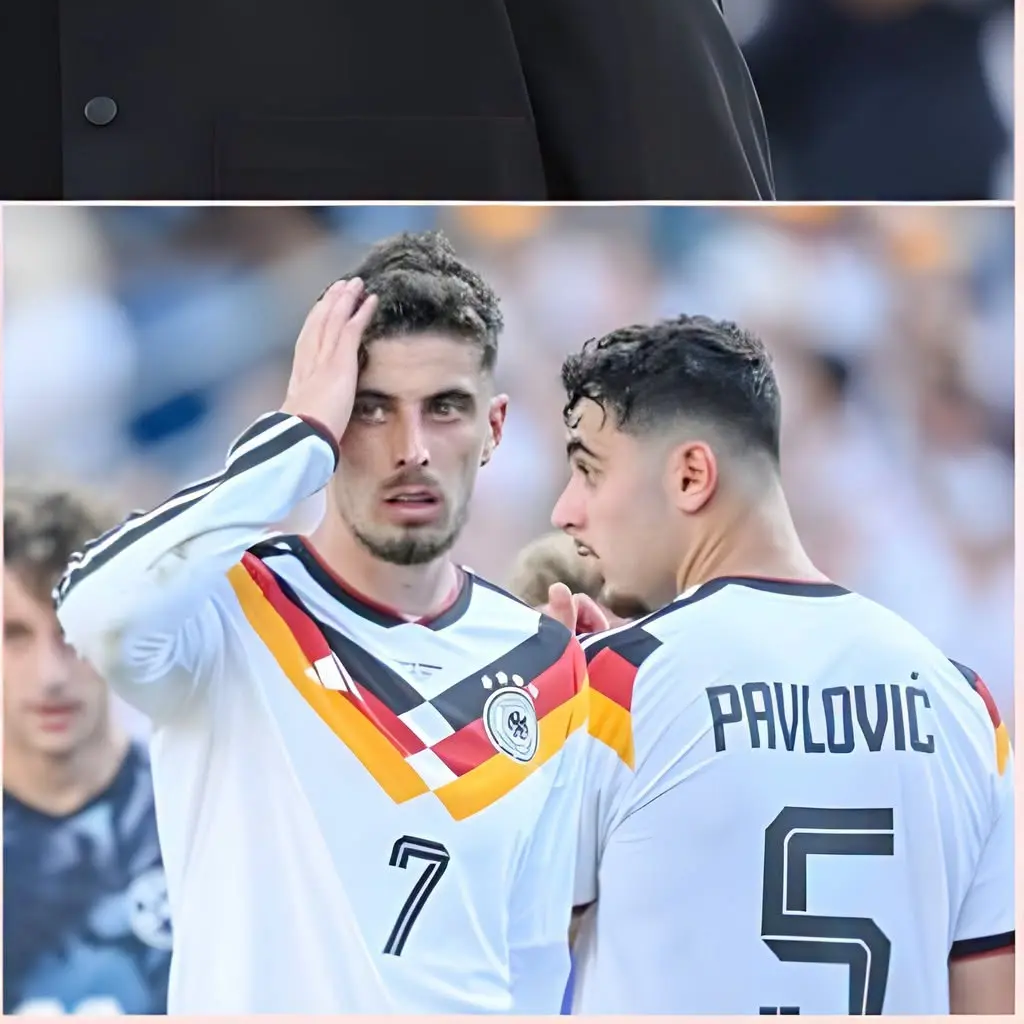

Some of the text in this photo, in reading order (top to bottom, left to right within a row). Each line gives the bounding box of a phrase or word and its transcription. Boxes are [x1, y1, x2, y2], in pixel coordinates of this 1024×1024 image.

[706, 671, 935, 754] PAVLOVIĆ
[383, 835, 450, 956] 7
[761, 806, 895, 1015] 5
